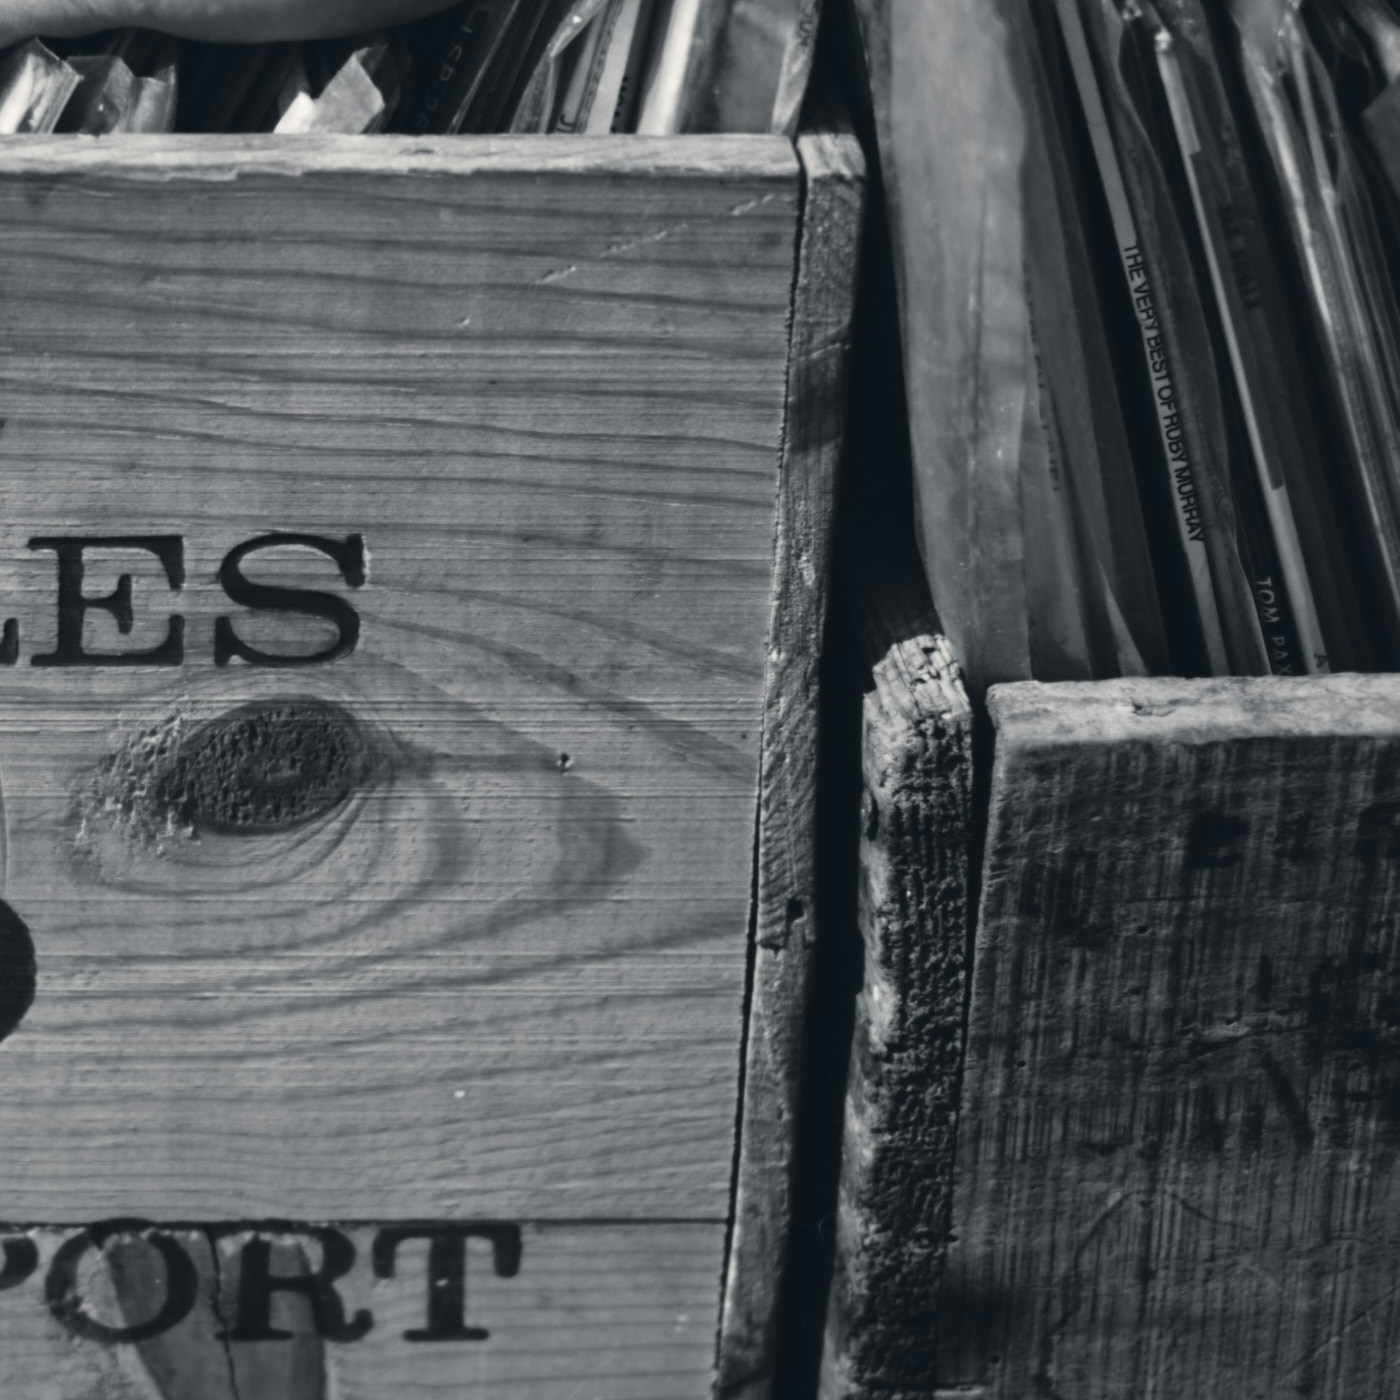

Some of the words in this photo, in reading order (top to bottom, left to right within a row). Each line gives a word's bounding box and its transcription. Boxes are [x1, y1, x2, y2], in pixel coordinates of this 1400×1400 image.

[1124, 245, 1145, 281] THE
[1133, 277, 1159, 330] VERY
[1146, 336, 1168, 381] BEST
[1157, 384, 1178, 411] OF
[1162, 412, 1187, 462] RUBY
[1173, 464, 1205, 543] MURRAY
[1256, 576, 1281, 624] TOM
